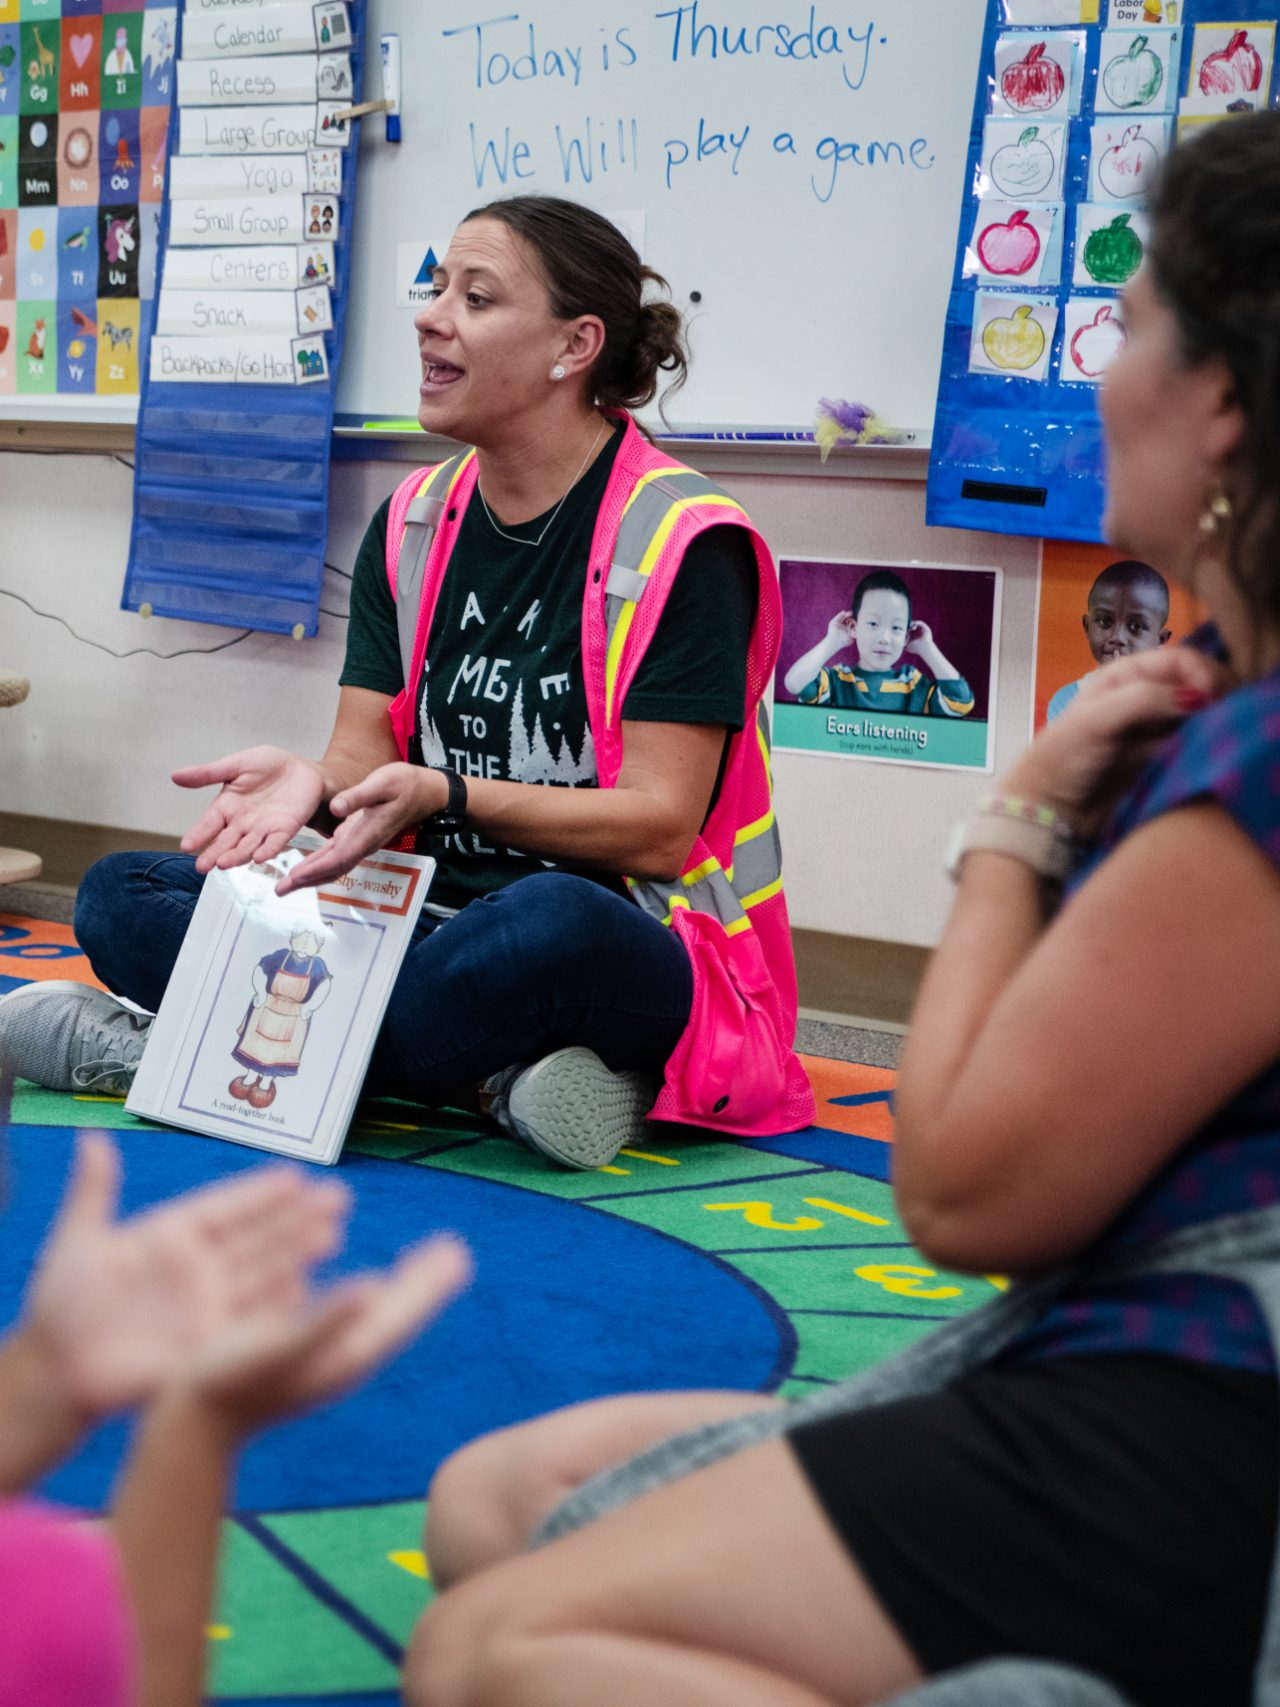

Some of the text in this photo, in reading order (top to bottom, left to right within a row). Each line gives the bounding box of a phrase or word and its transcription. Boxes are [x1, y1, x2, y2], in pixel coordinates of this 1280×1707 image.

[1114, 0, 1144, 8] Labor
[1117, 10, 1138, 21] Day
[214, 24, 283, 49] Calendar
[442, 1, 887, 90] Today is Thursday.
[30, 86, 48, 102] Gg
[70, 83, 88, 97] Hh
[116, 79, 126, 94] Ii
[158, 77, 168, 94] Jj
[210, 68, 276, 96] Recess
[205, 117, 317, 151] Large Group
[469, 116, 936, 202] We Will play a game.
[26, 180, 50, 193] Mm
[70, 178, 87, 192] Nn
[111, 175, 130, 190] Oo
[241, 160, 294, 194] Yoga
[193, 208, 289, 234] Small Group
[109, 271, 126, 285] Uu
[210, 255, 290, 282] Centers
[193, 302, 247, 328] Snack
[69, 364, 84, 382] Yy
[109, 365, 125, 379] Zz
[459, 714, 486, 739] TO
[827, 716, 928, 749] Ears listening
[874, 742, 889, 752] with
[449, 749, 500, 779] THE
[336, 873, 402, 899] shy-washy
[220, 1103, 267, 1120] read-together
[269, 1113, 286, 1124] book
